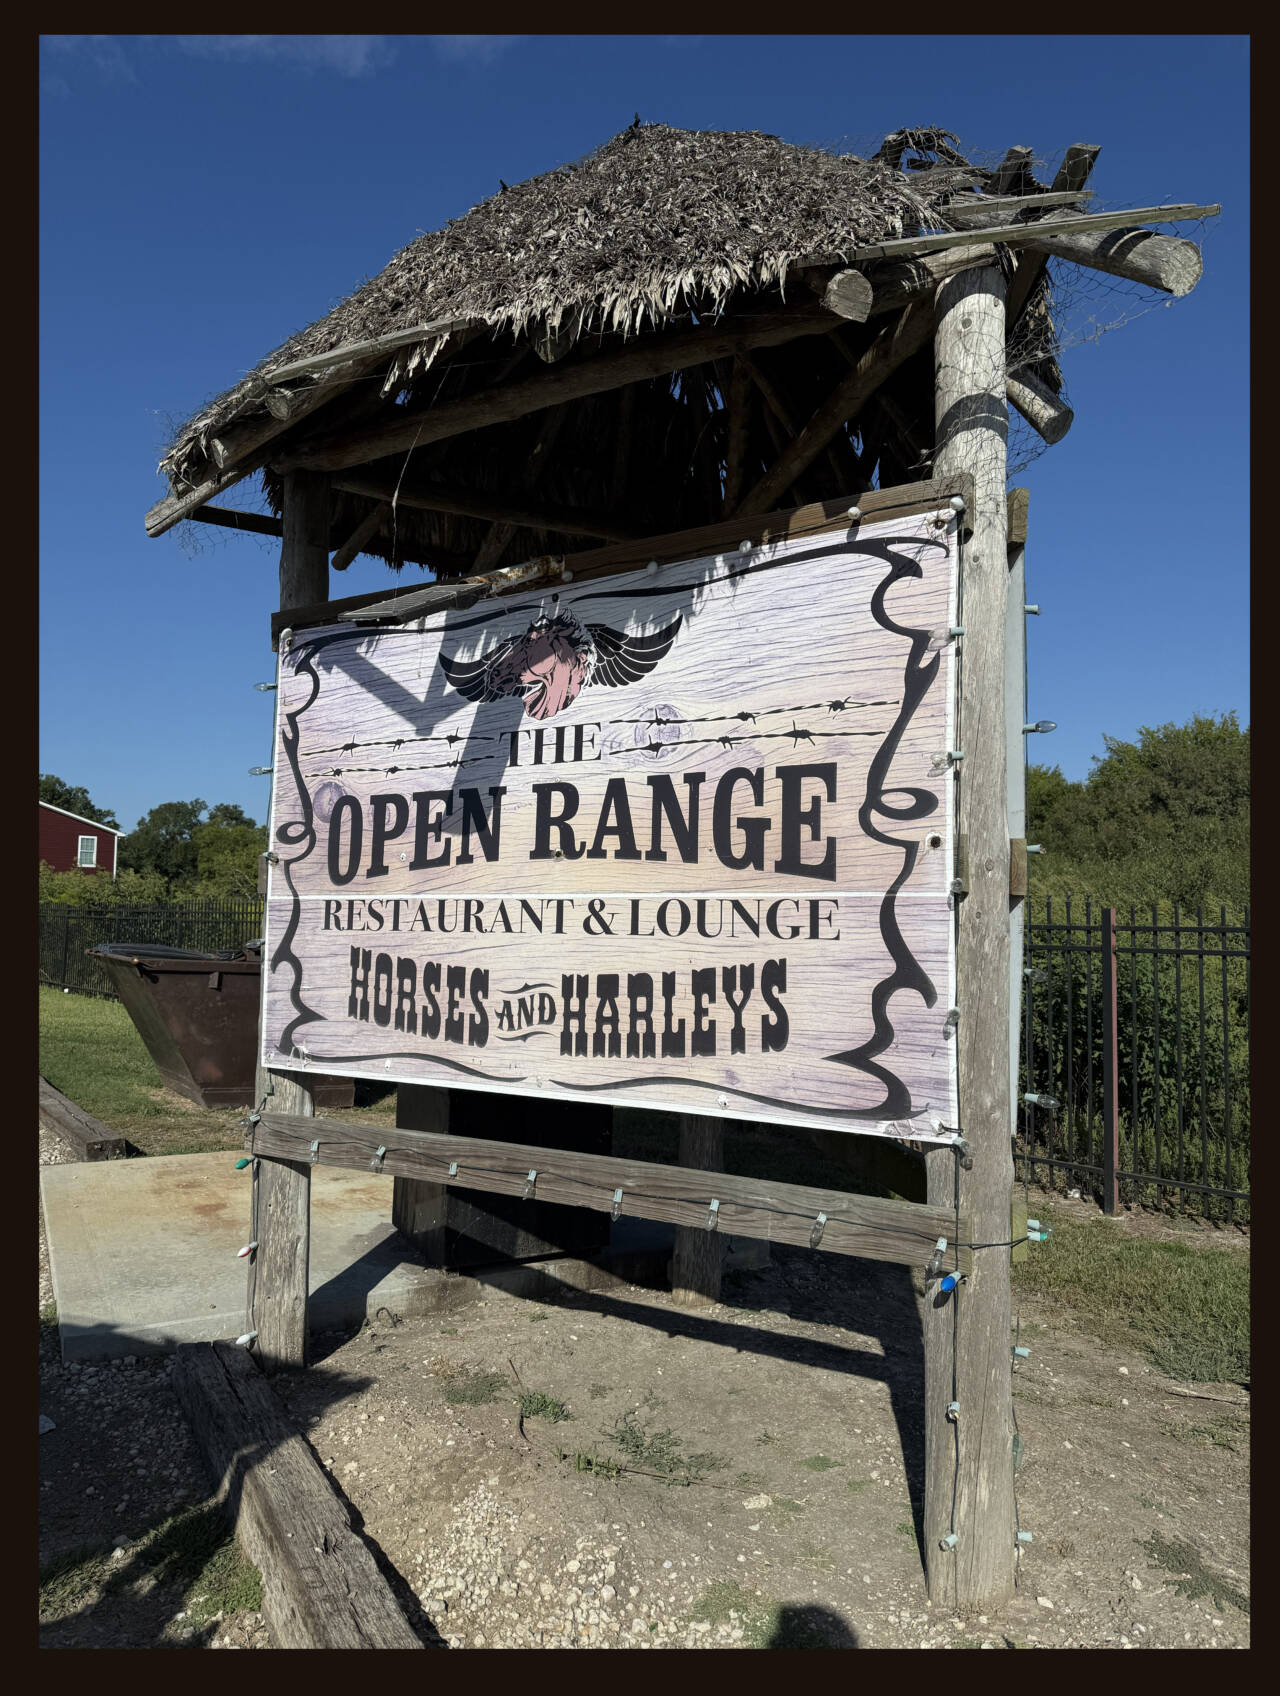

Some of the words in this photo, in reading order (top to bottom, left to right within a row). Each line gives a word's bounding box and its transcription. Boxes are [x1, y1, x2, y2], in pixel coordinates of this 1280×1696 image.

[499, 722, 602, 766] THE
[328, 786, 506, 886] OPEN
[529, 762, 837, 882] RANGE
[322, 899, 574, 935] RESTAURANT
[582, 898, 617, 936] &
[629, 899, 841, 941] LOUNGE
[348, 945, 490, 1047] HORSES
[495, 993, 557, 1033] AND
[560, 957, 788, 1058] HARLEYS
